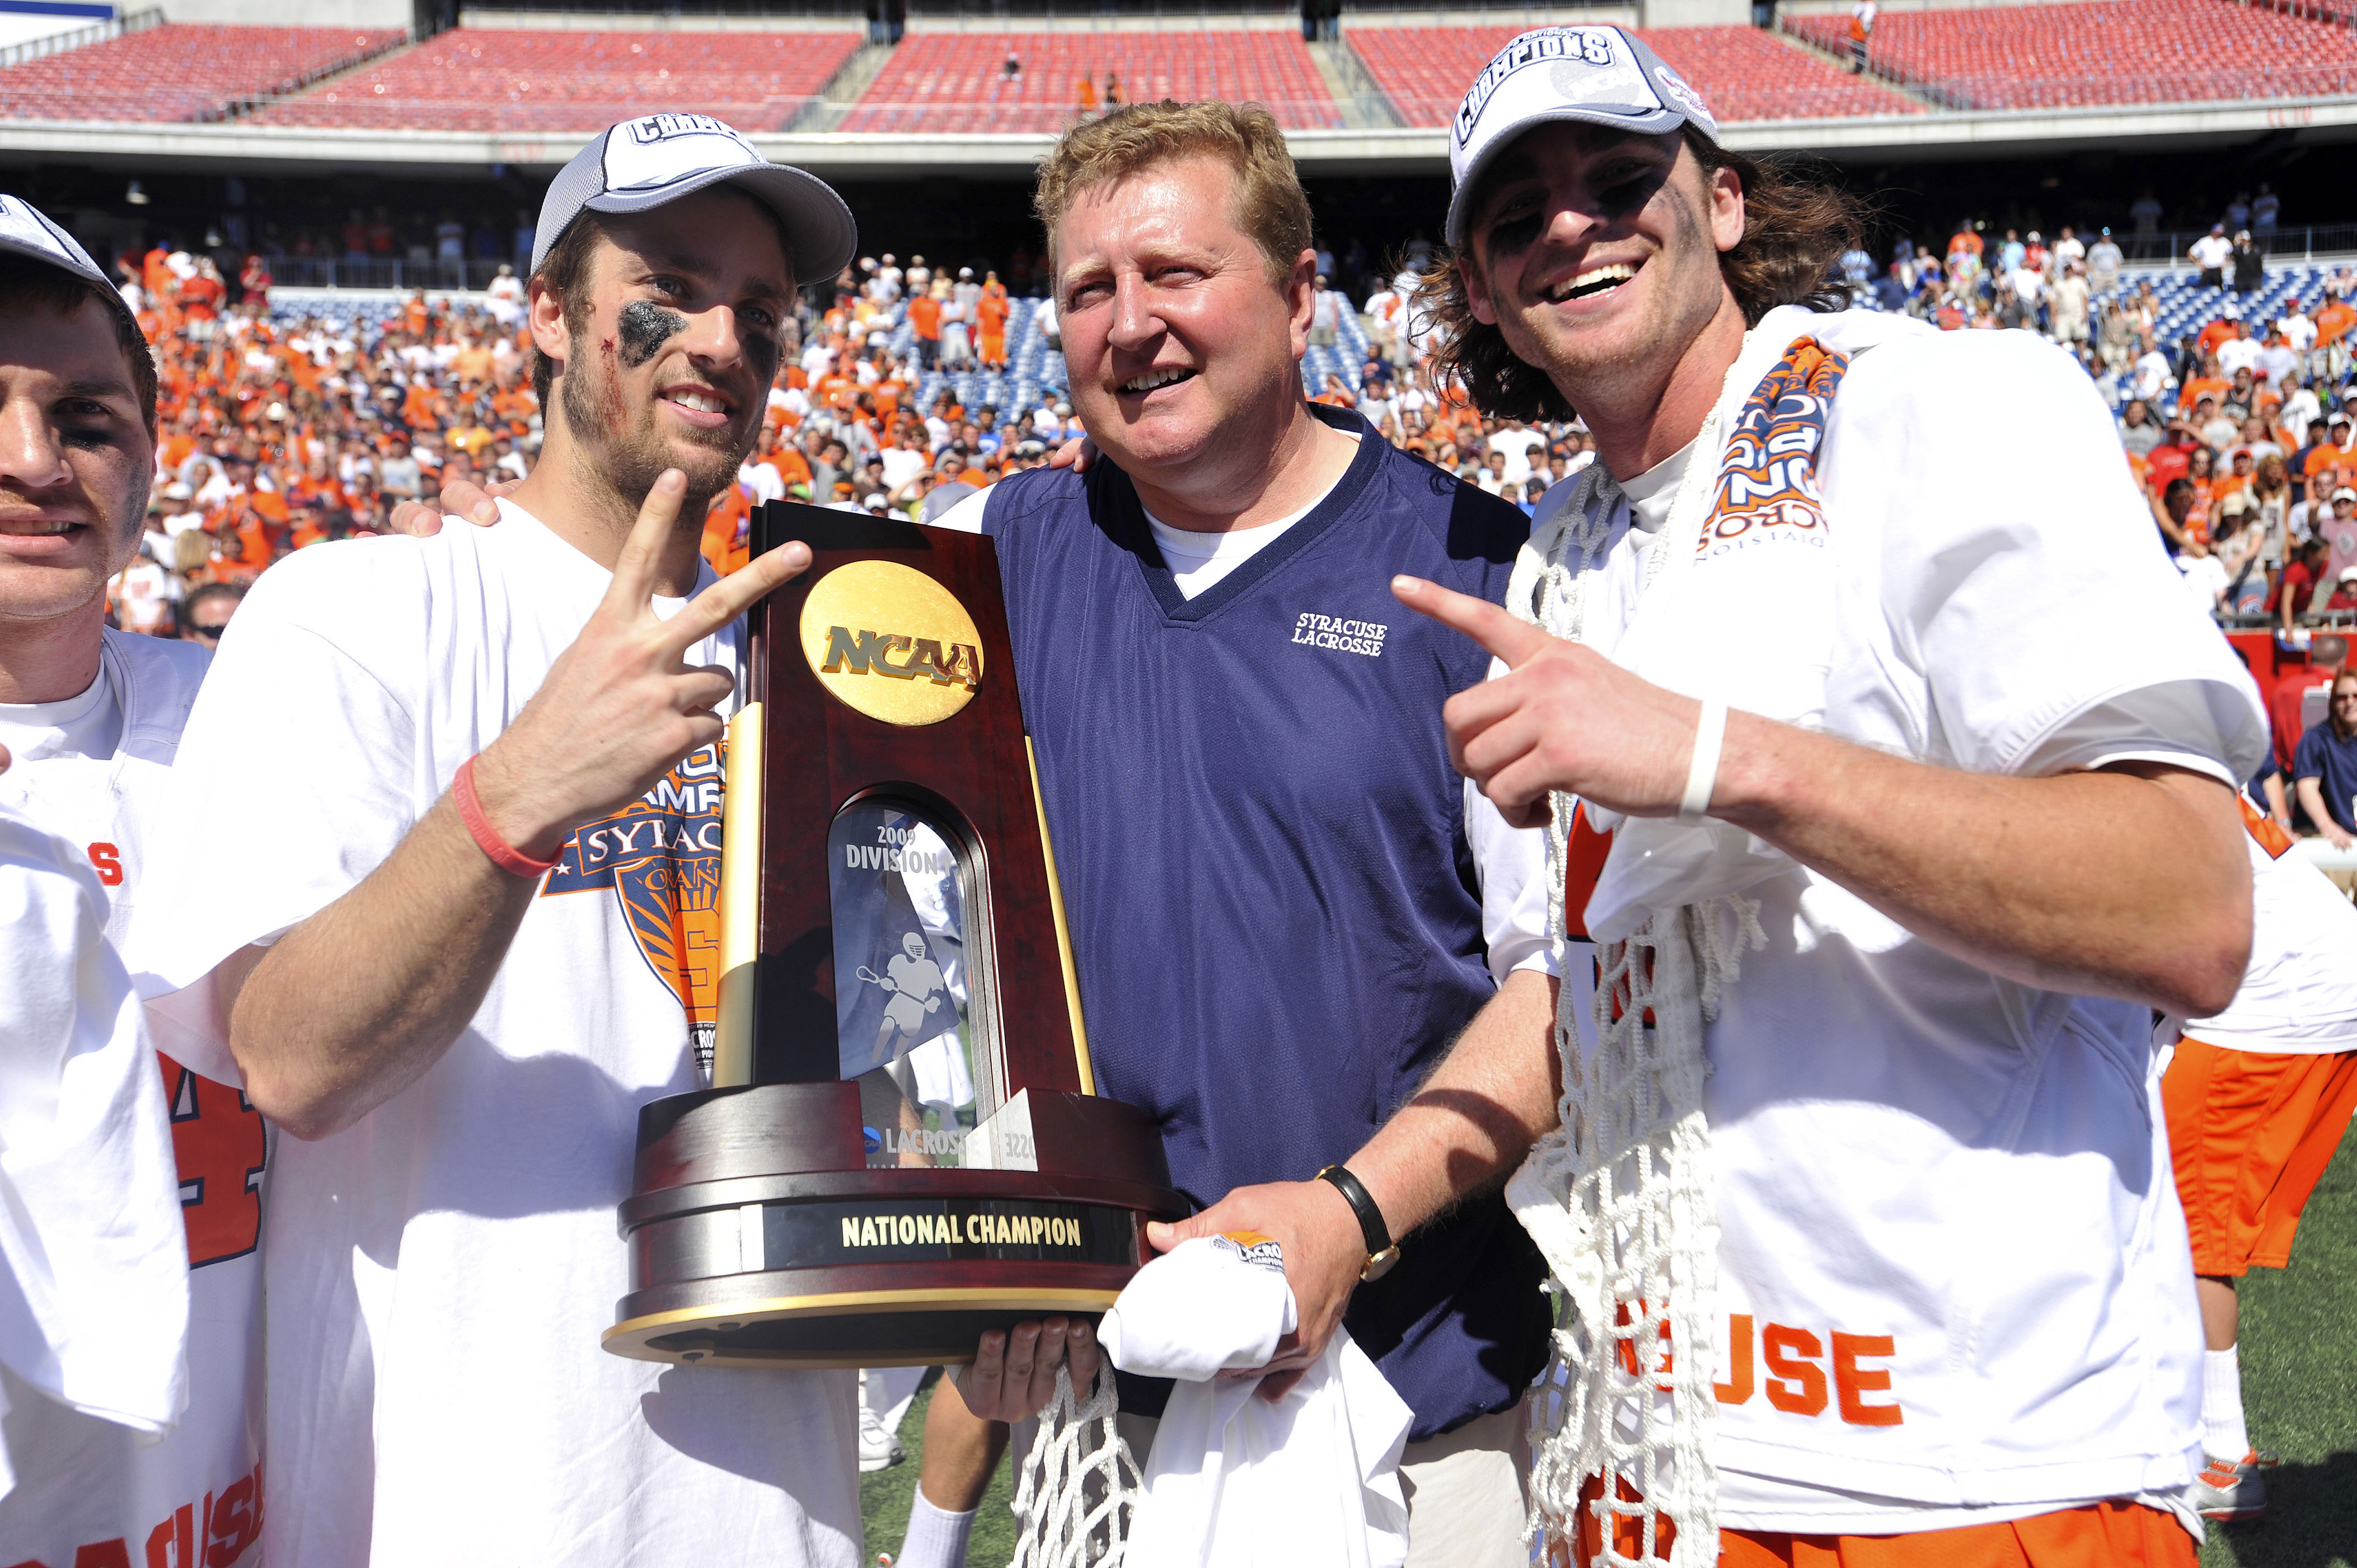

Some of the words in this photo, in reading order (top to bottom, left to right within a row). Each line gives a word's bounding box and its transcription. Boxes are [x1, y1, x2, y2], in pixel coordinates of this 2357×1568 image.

[1455, 32, 1613, 147] CHAMPIONS
[1291, 627, 1384, 658] LACROSSE
[1296, 612, 1388, 641] SYRACUSE
[820, 625, 982, 694] NCAA
[877, 825, 916, 846] 2009
[87, 842, 124, 886] S
[846, 844, 938, 875] DIVISION
[841, 1214, 964, 1247] NATIONAL
[966, 1214, 1081, 1247] CHAMPION
